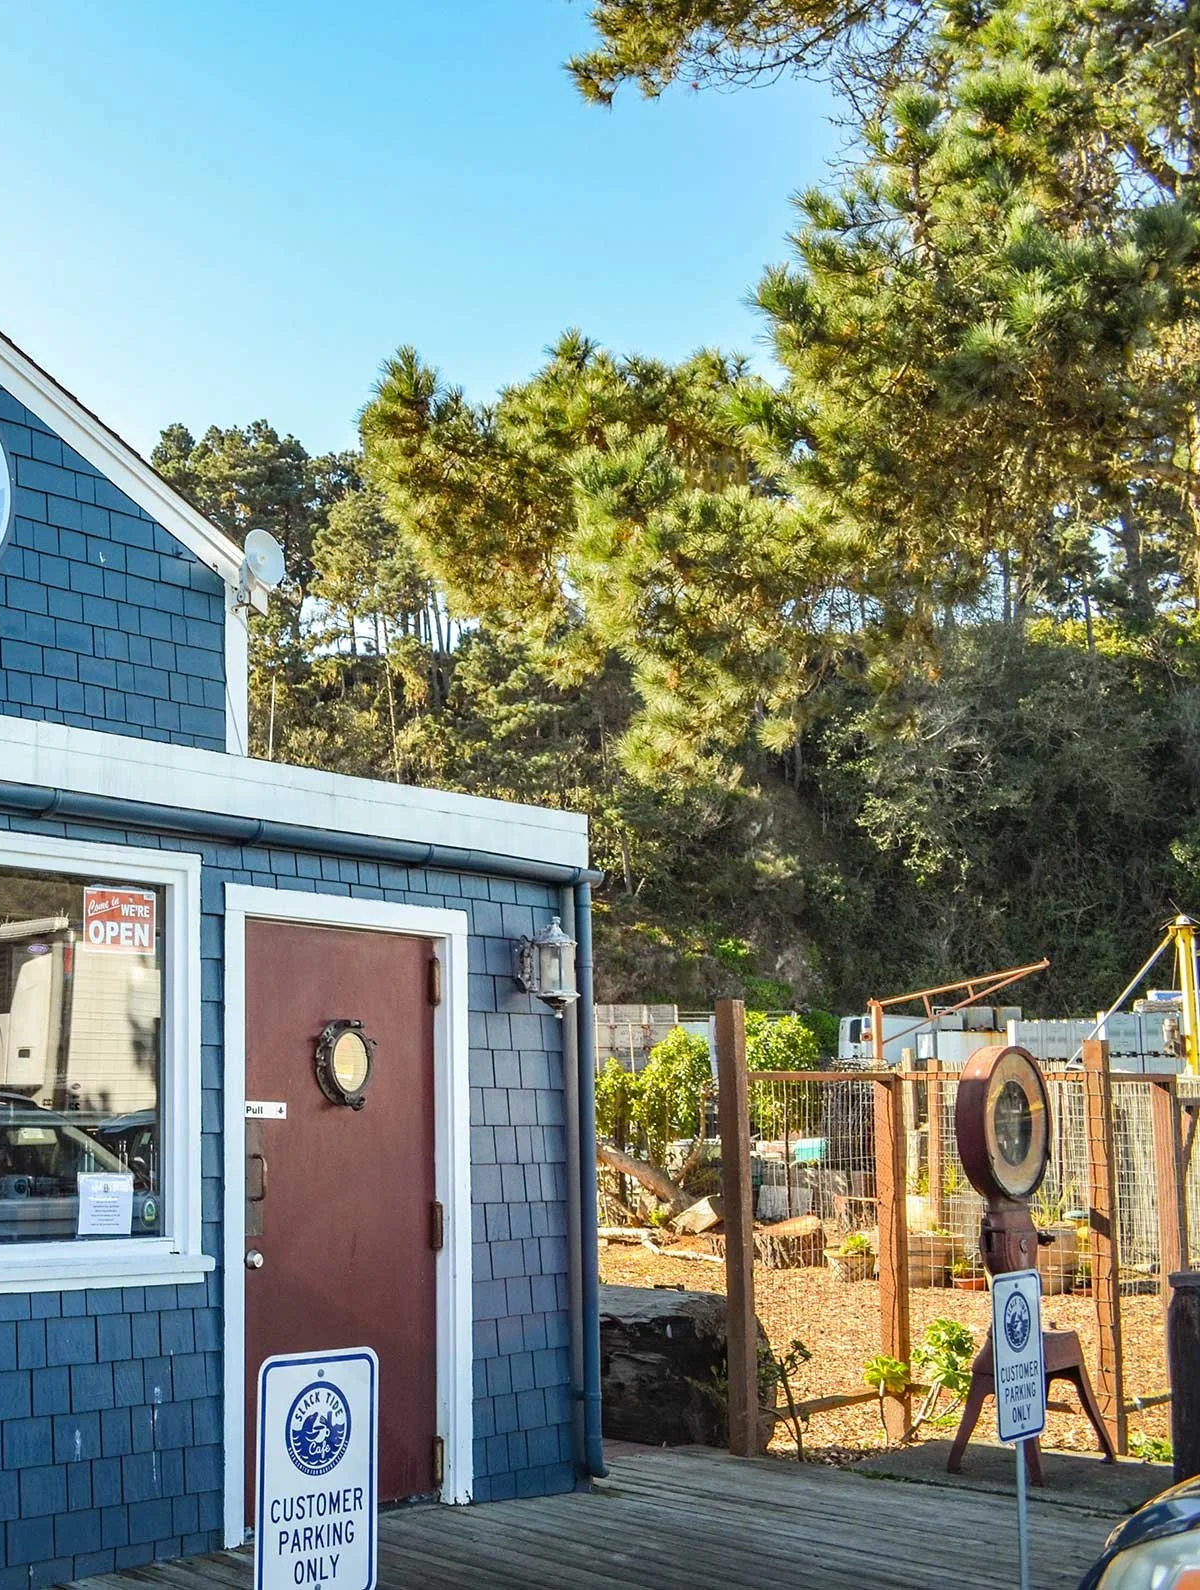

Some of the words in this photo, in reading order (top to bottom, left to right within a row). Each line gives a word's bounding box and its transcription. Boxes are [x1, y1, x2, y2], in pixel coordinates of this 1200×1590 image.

[88, 899, 109, 916] Come
[121, 903, 150, 918] WE'RE
[89, 920, 150, 947] OPEN
[246, 1105, 263, 1114] Pull
[1000, 1360, 1039, 1383] CUSTOMER
[1005, 1382, 1037, 1404] PARKING
[295, 1391, 320, 1422] SLACK
[326, 1392, 343, 1417] TIDE
[1012, 1404, 1031, 1424] ONLY
[308, 1440, 331, 1459] Cafe
[270, 1487, 364, 1524] CUSTOMER
[278, 1520, 355, 1555] PARKING
[294, 1554, 340, 1585] ONLY
